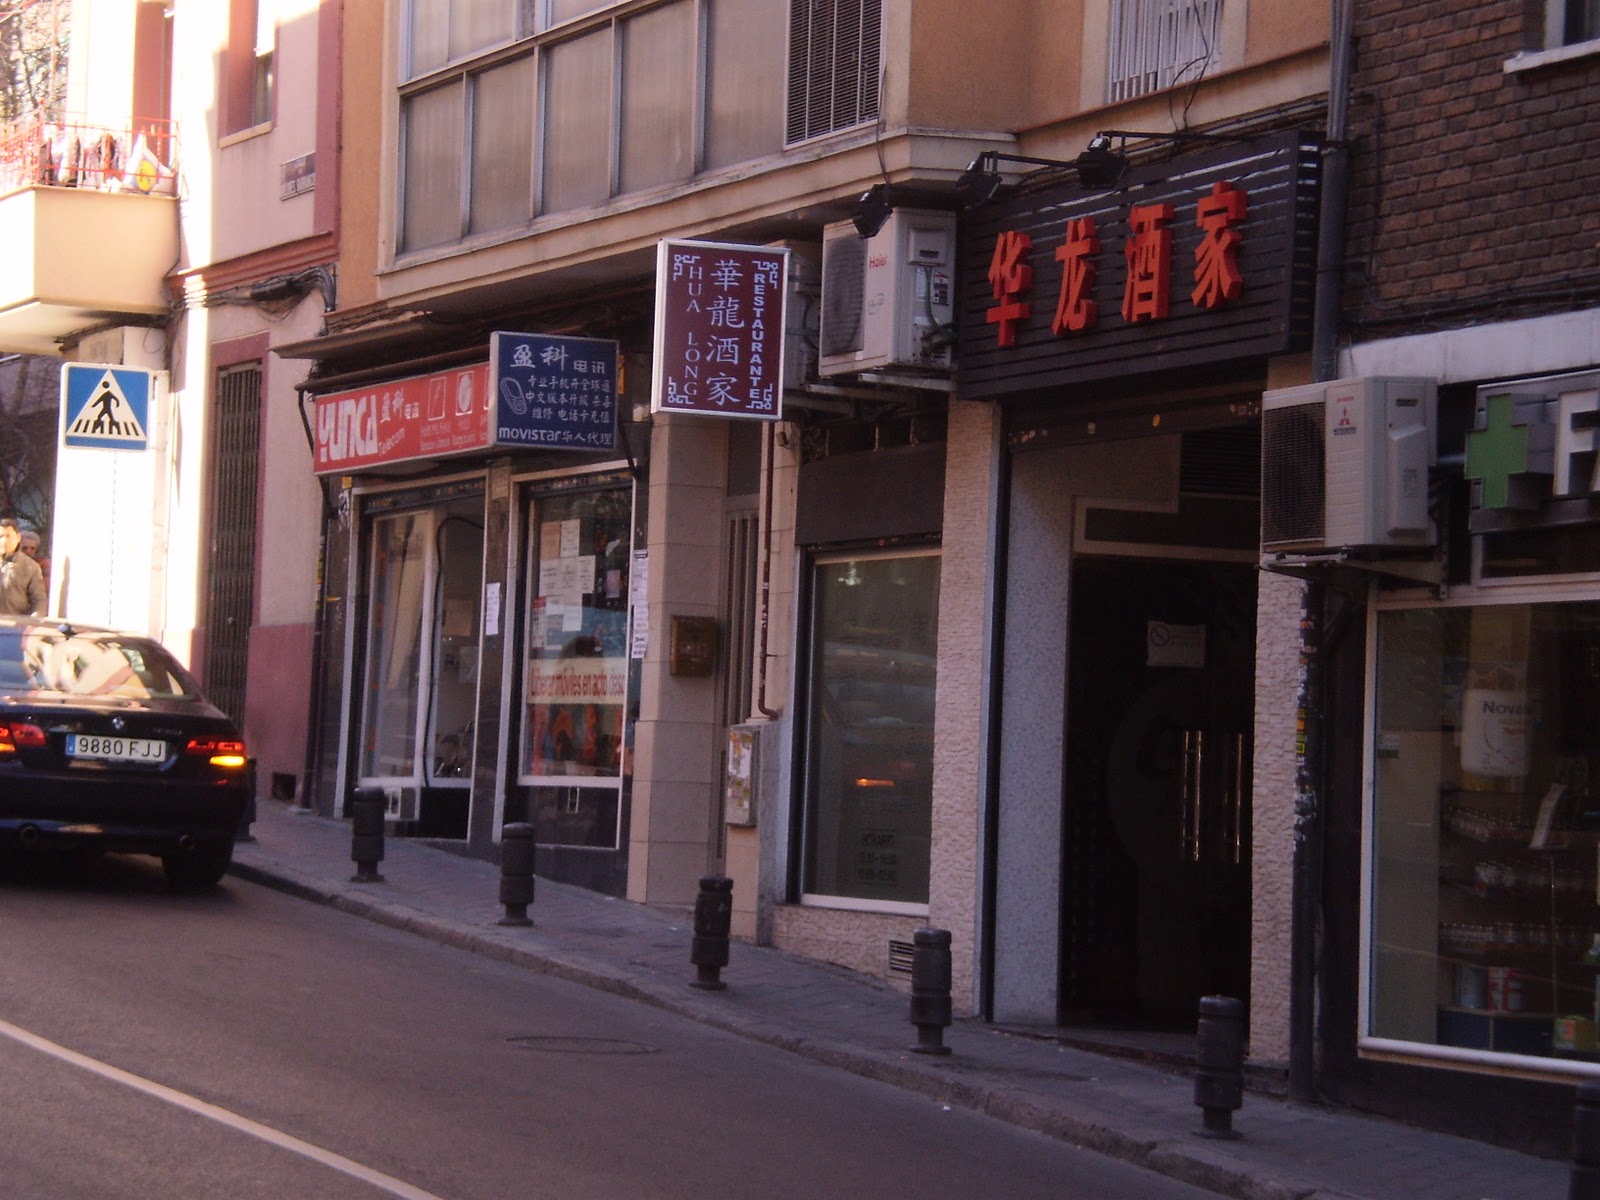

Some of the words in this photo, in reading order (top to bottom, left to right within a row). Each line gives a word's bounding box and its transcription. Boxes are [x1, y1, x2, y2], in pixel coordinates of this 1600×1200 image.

[686, 266, 703, 313] HUA
[986, 181, 1248, 346] 华龙酒家
[684, 332, 701, 396] LONG
[706, 260, 744, 406] 華龍酒家
[750, 273, 766, 399] RESTAURANTE
[499, 427, 562, 442] movistar
[1553, 388, 1600, 497] F
[79, 737, 123, 755] 9880
[129, 741, 162, 758] FJJ
